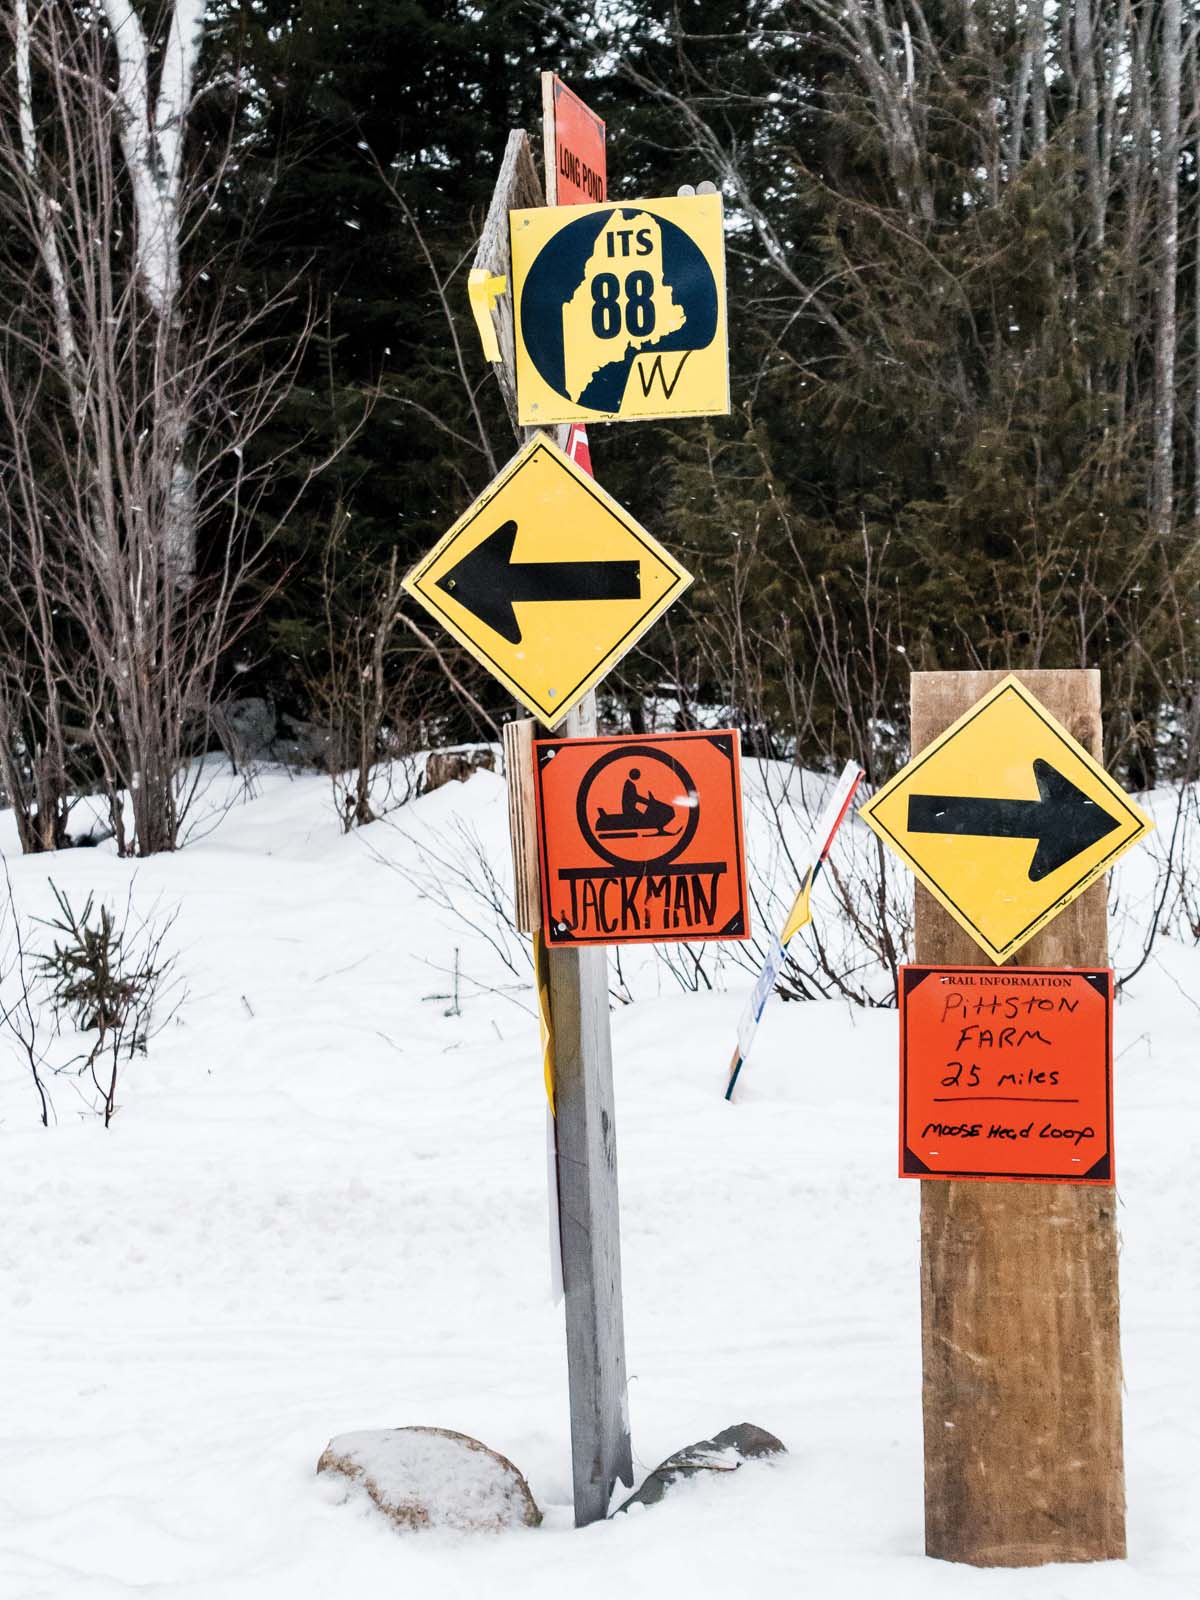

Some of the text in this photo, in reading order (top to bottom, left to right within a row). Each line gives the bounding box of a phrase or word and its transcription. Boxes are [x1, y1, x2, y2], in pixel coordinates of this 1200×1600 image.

[559, 143, 603, 203] LONG POND
[606, 229, 654, 257] ITS
[591, 270, 656, 340] 88
[637, 351, 692, 400] W
[560, 872, 721, 934] JACKMAN
[940, 976, 1072, 988] TRAIL INFORMATION
[956, 1024, 1052, 1052] FARM
[940, 1062, 981, 1087] 25
[921, 1123, 983, 1139] MOOSE
